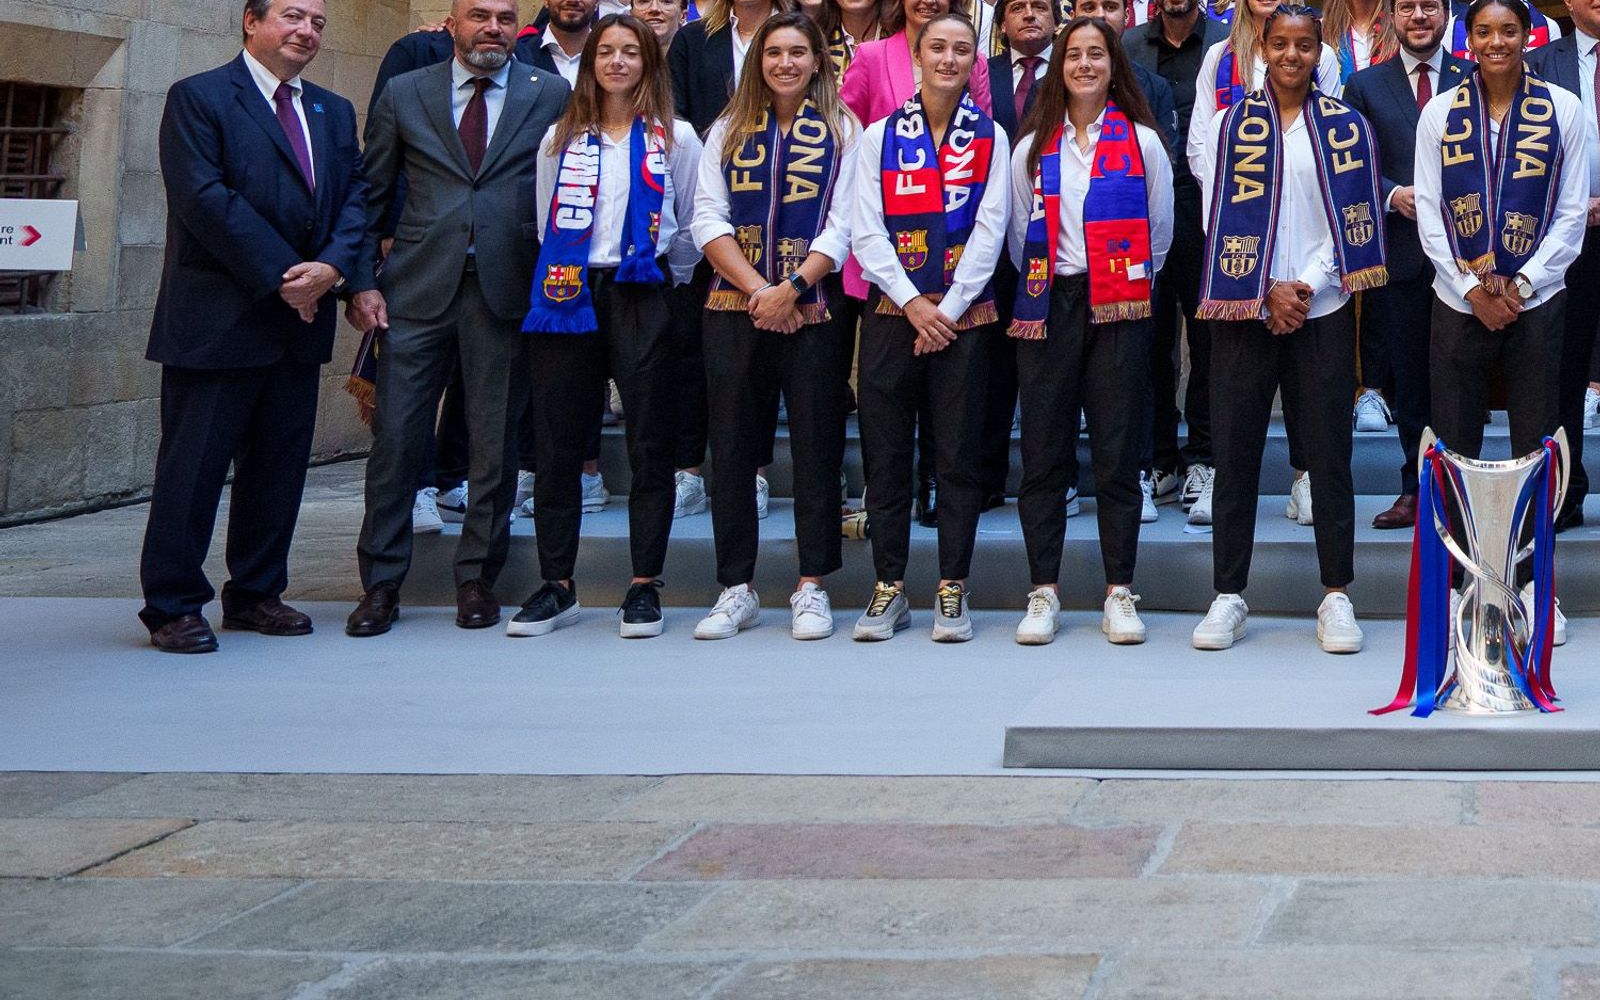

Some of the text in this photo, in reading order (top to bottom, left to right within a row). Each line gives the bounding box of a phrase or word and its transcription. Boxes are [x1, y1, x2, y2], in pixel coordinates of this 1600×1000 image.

[1451, 77, 1471, 109] B
[895, 147, 927, 195] FC
[1328, 121, 1364, 175] FC
